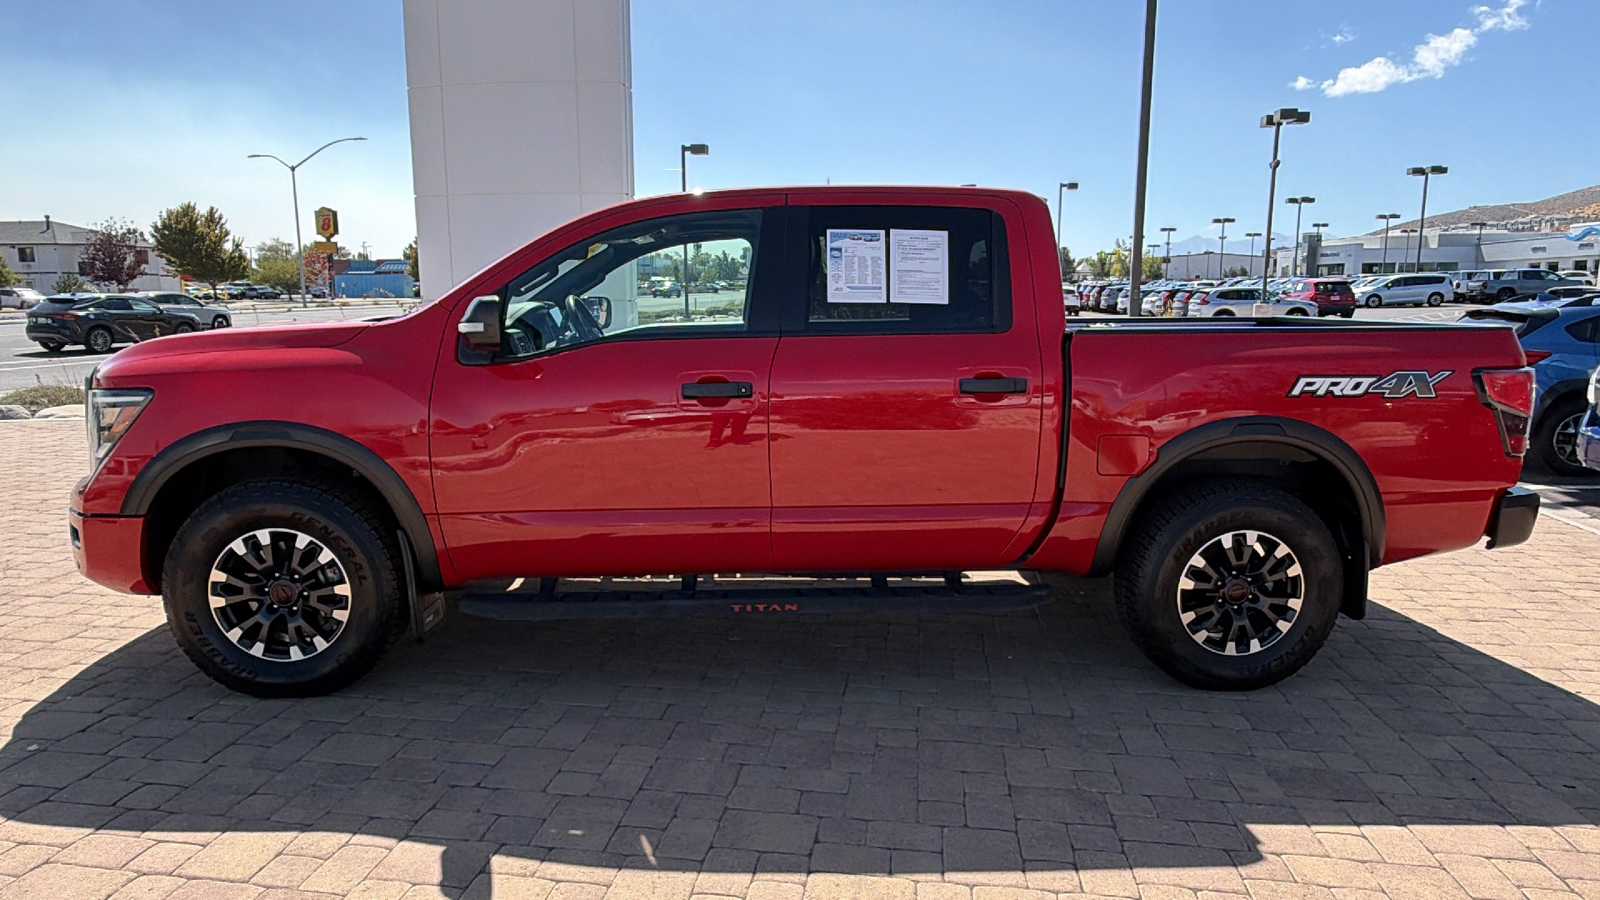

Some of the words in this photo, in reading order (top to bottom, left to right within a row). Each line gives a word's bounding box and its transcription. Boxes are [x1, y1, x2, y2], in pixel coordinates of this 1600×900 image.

[321, 217, 331, 231] 8
[289, 511, 369, 586] GENERAL
[729, 603, 798, 613] TITAN
[184, 611, 259, 680] GRABBER
